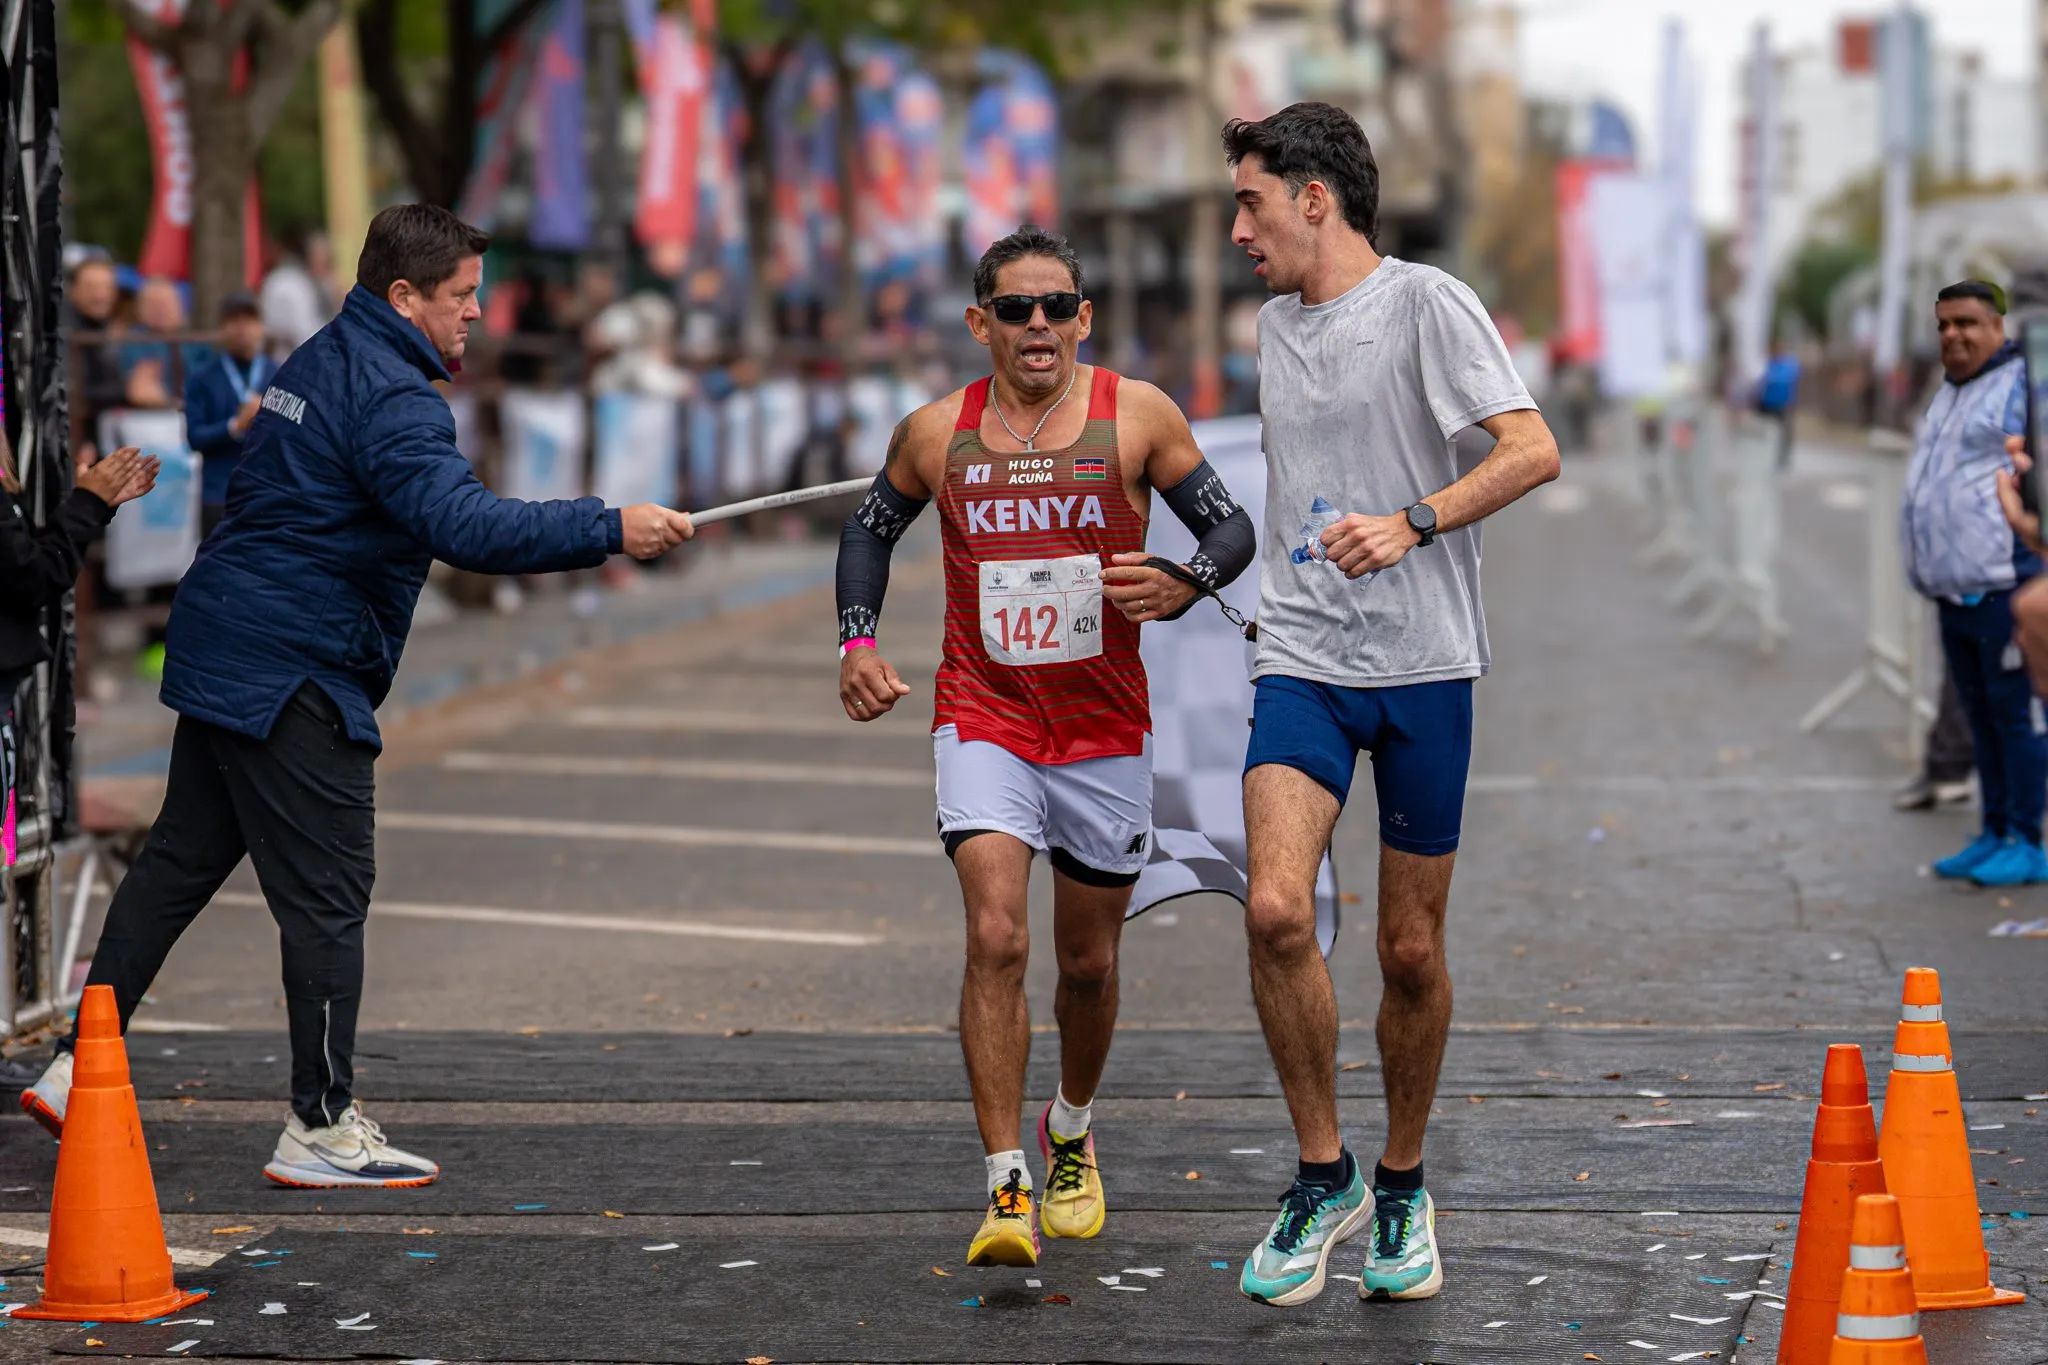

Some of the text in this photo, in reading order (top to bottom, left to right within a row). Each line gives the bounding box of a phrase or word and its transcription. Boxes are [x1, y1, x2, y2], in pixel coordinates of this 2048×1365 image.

[1008, 458, 1054, 471] HUGO
[1008, 471, 1054, 485] ACUÑA
[966, 495, 1107, 534] KENYA
[993, 605, 1060, 652] 142
[1073, 614, 1098, 635] 42K
